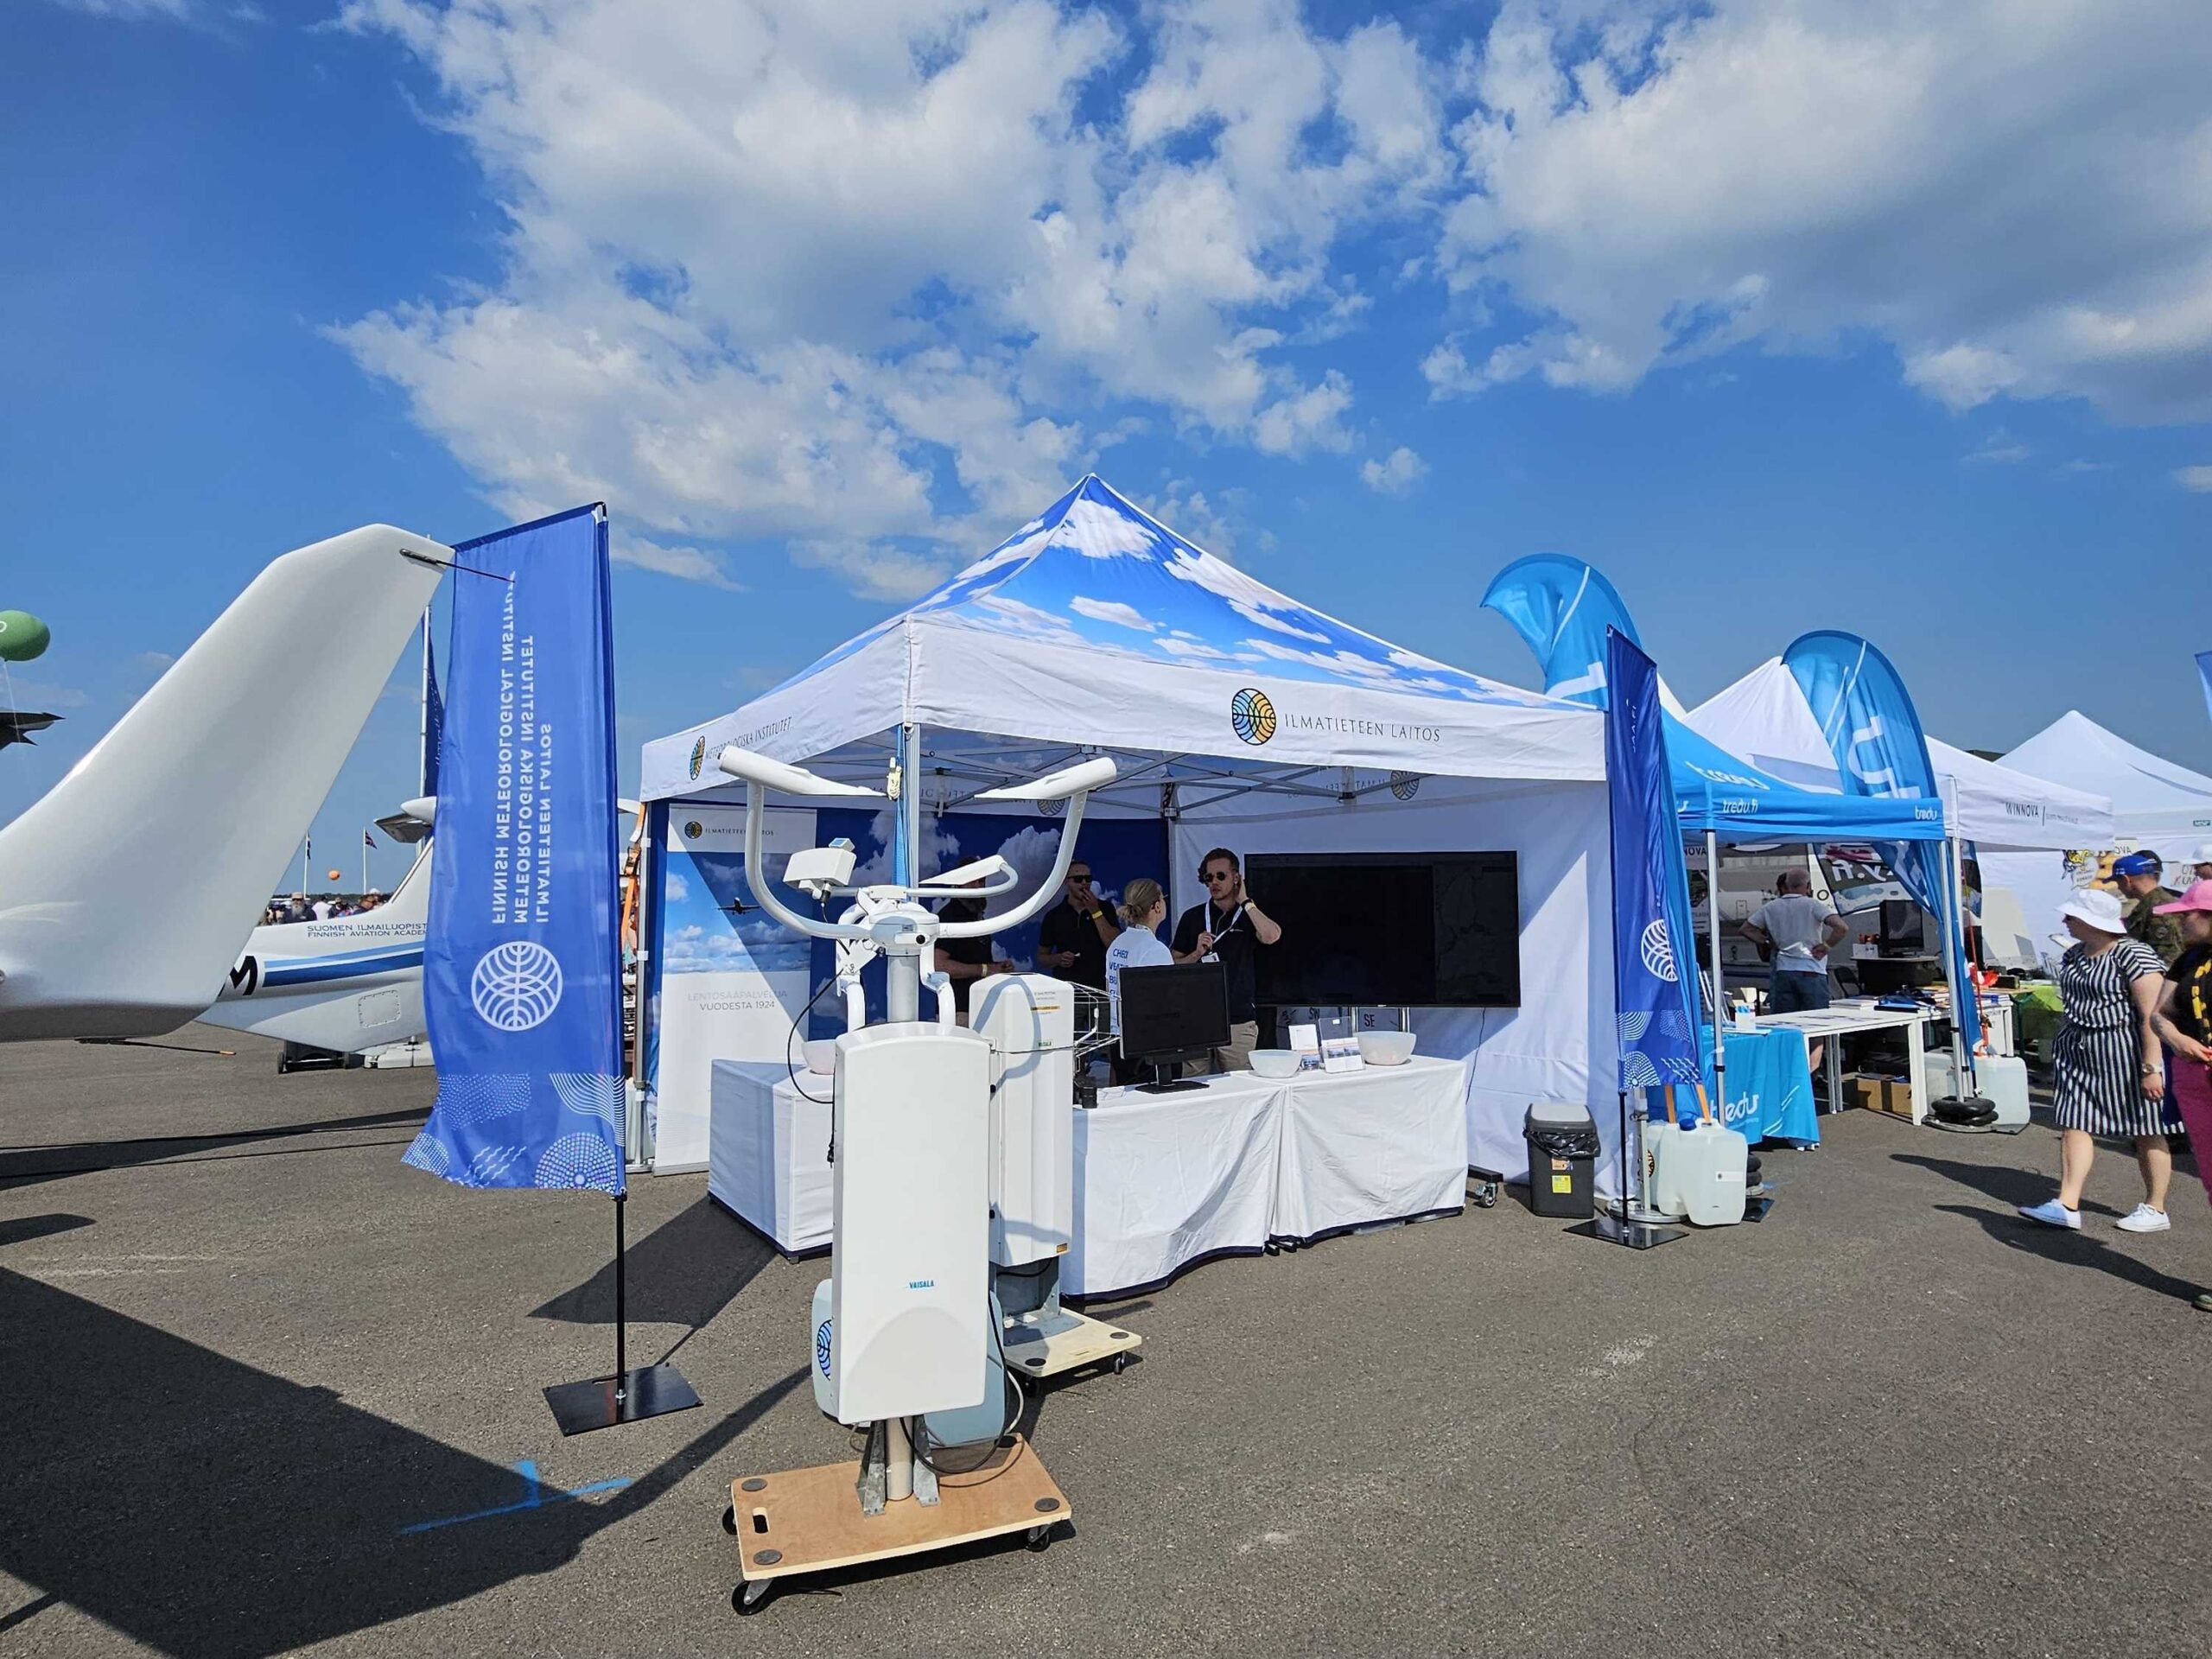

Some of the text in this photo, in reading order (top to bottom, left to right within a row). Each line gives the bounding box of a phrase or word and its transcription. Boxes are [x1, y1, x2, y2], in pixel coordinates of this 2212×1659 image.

[1284, 714, 1440, 742] ILMATIETEEN LAITOS
[1722, 798, 1758, 813] tredu.fi
[1915, 805, 1937, 820] tredu
[2005, 802, 2039, 817] WINNOVA
[307, 923, 428, 932] SUOMEN ILMAILUOPIST
[216, 956, 258, 996] M
[700, 1001, 775, 1011] VUODESTA 1924
[1363, 1014, 1376, 1027] SE
[909, 1280, 934, 1288] VAISALA
